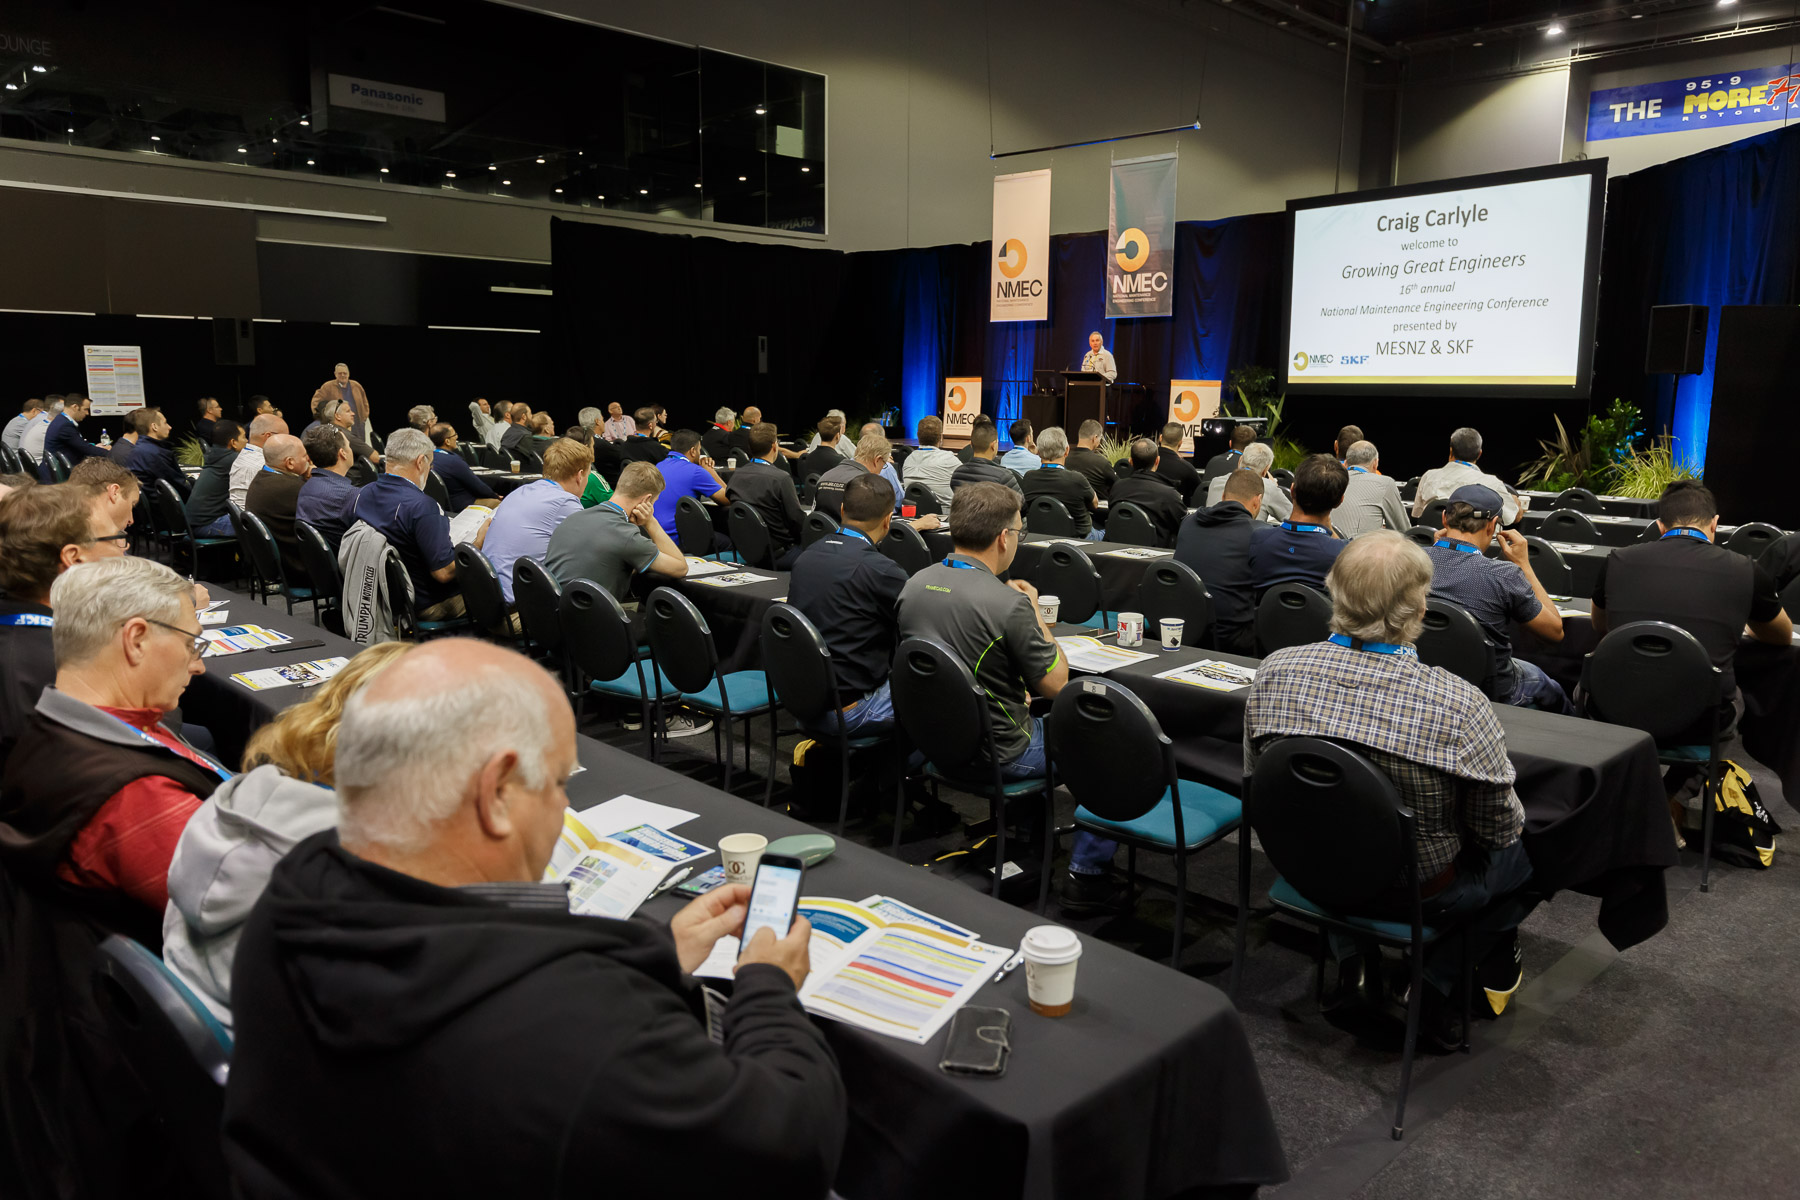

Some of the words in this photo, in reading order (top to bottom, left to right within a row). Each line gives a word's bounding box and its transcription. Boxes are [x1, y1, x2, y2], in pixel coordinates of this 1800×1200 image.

[351, 83, 424, 105] Panasonic
[1683, 85, 1769, 114] MORE
[1609, 98, 1663, 123] THE
[1377, 212, 1420, 233] Craig
[1425, 203, 1489, 228] Carlyle
[1401, 239, 1445, 251] welcome
[1447, 237, 1459, 247] to
[1341, 262, 1399, 279] Growing
[1403, 258, 1445, 275] Great
[1449, 254, 1526, 274] Engineers
[996, 279, 1043, 299] NMEC
[1112, 271, 1168, 294] NMEC
[1399, 283, 1419, 296] 16th
[1420, 281, 1456, 294] annual
[1320, 305, 1358, 317] National
[1360, 303, 1422, 316] Maintenance
[1424, 299, 1484, 313] Engineering
[1487, 296, 1550, 310] Conference
[1393, 320, 1442, 334] presented
[1444, 319, 1458, 332] by
[1376, 340, 1426, 355] MESNZ
[1430, 339, 1442, 355] &
[1446, 339, 1474, 354] SKF
[1309, 354, 1334, 364] NMEC
[1340, 355, 1370, 365] SKF
[946, 413, 976, 425] NMEC
[356, 602, 372, 644] TRIUMPH
[365, 565, 375, 603] MOTORCYCLES
